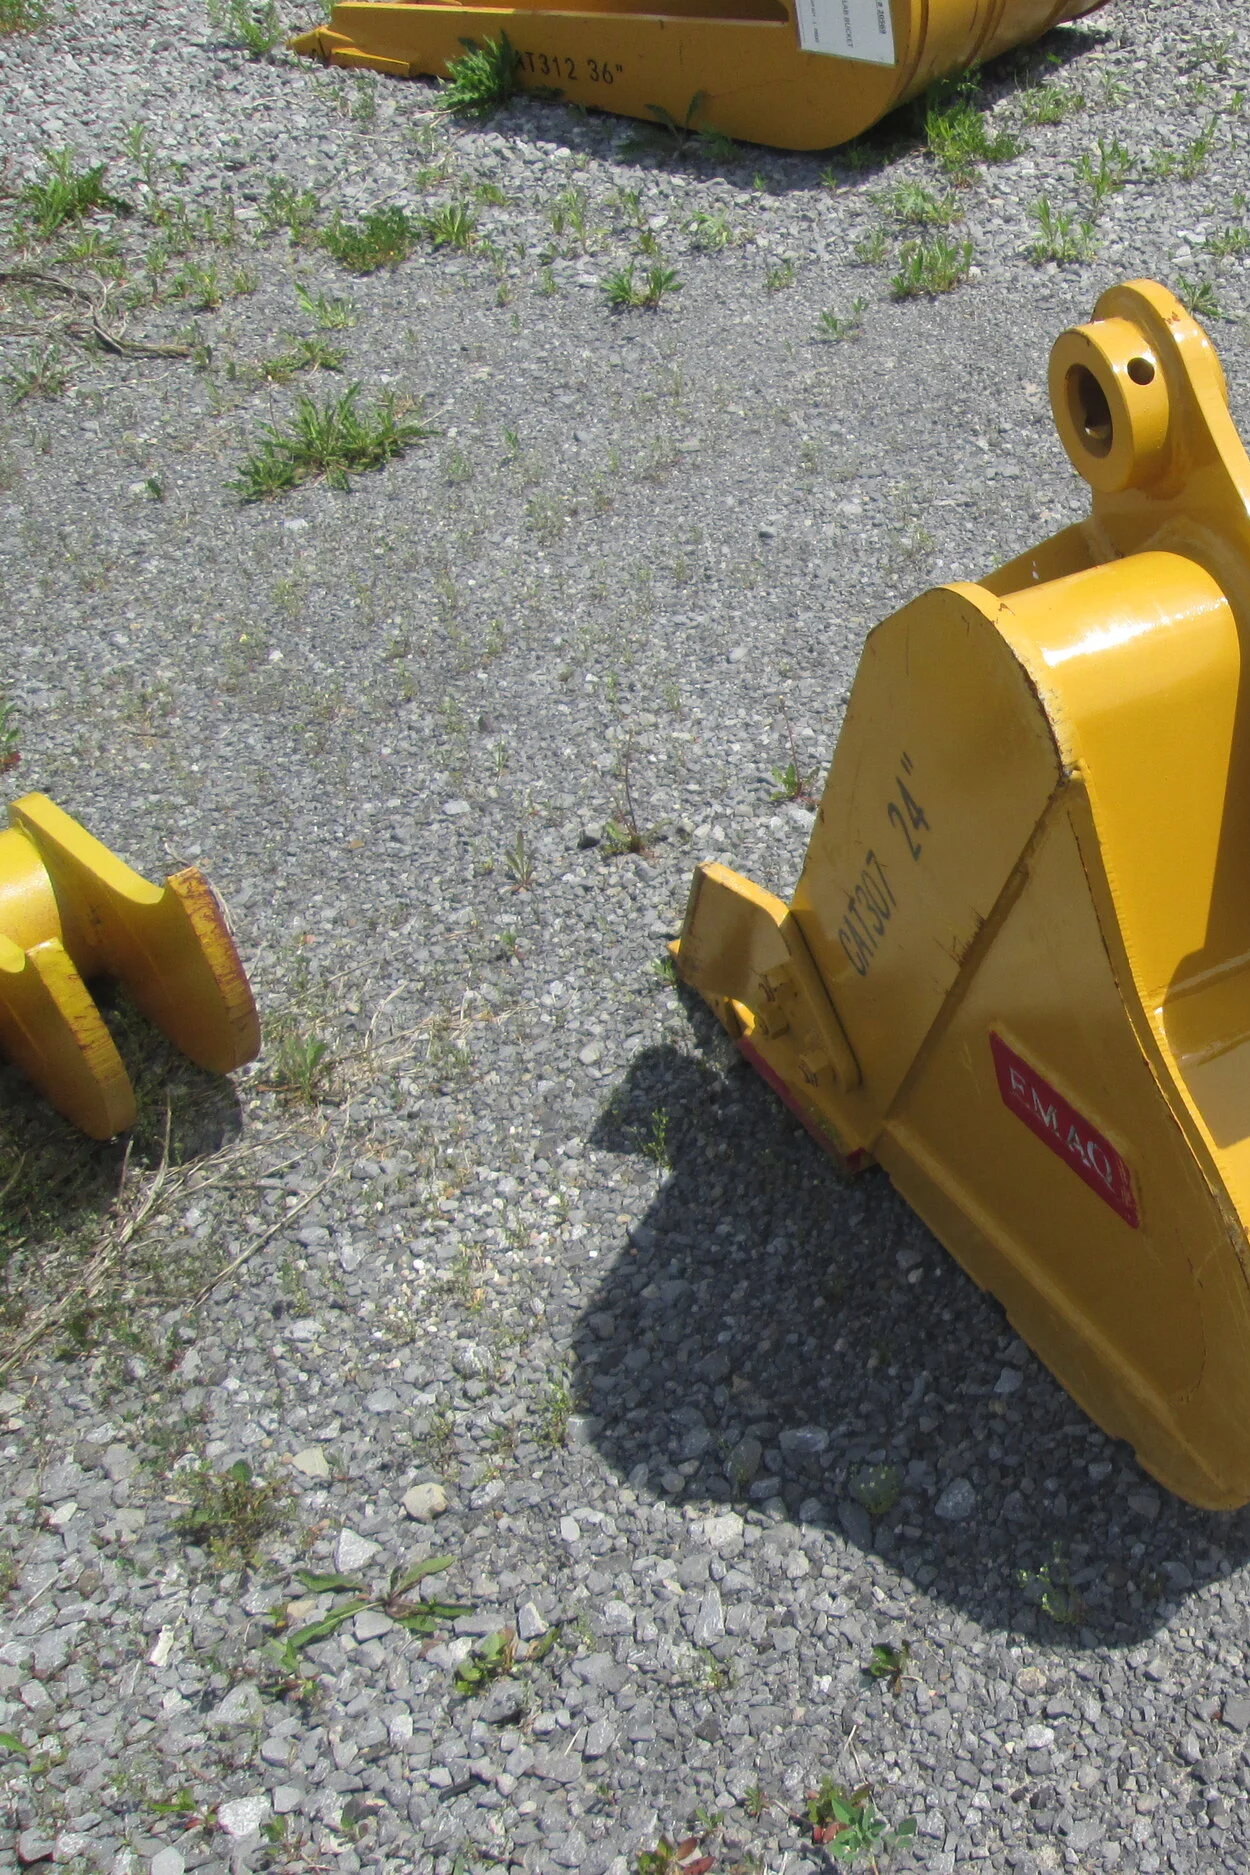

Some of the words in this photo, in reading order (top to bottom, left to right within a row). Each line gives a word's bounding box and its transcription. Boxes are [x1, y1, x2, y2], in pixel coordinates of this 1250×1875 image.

[587, 59, 623, 84] 36"
[839, 849, 897, 977] CAT307
[887, 751, 931, 862] 24"
